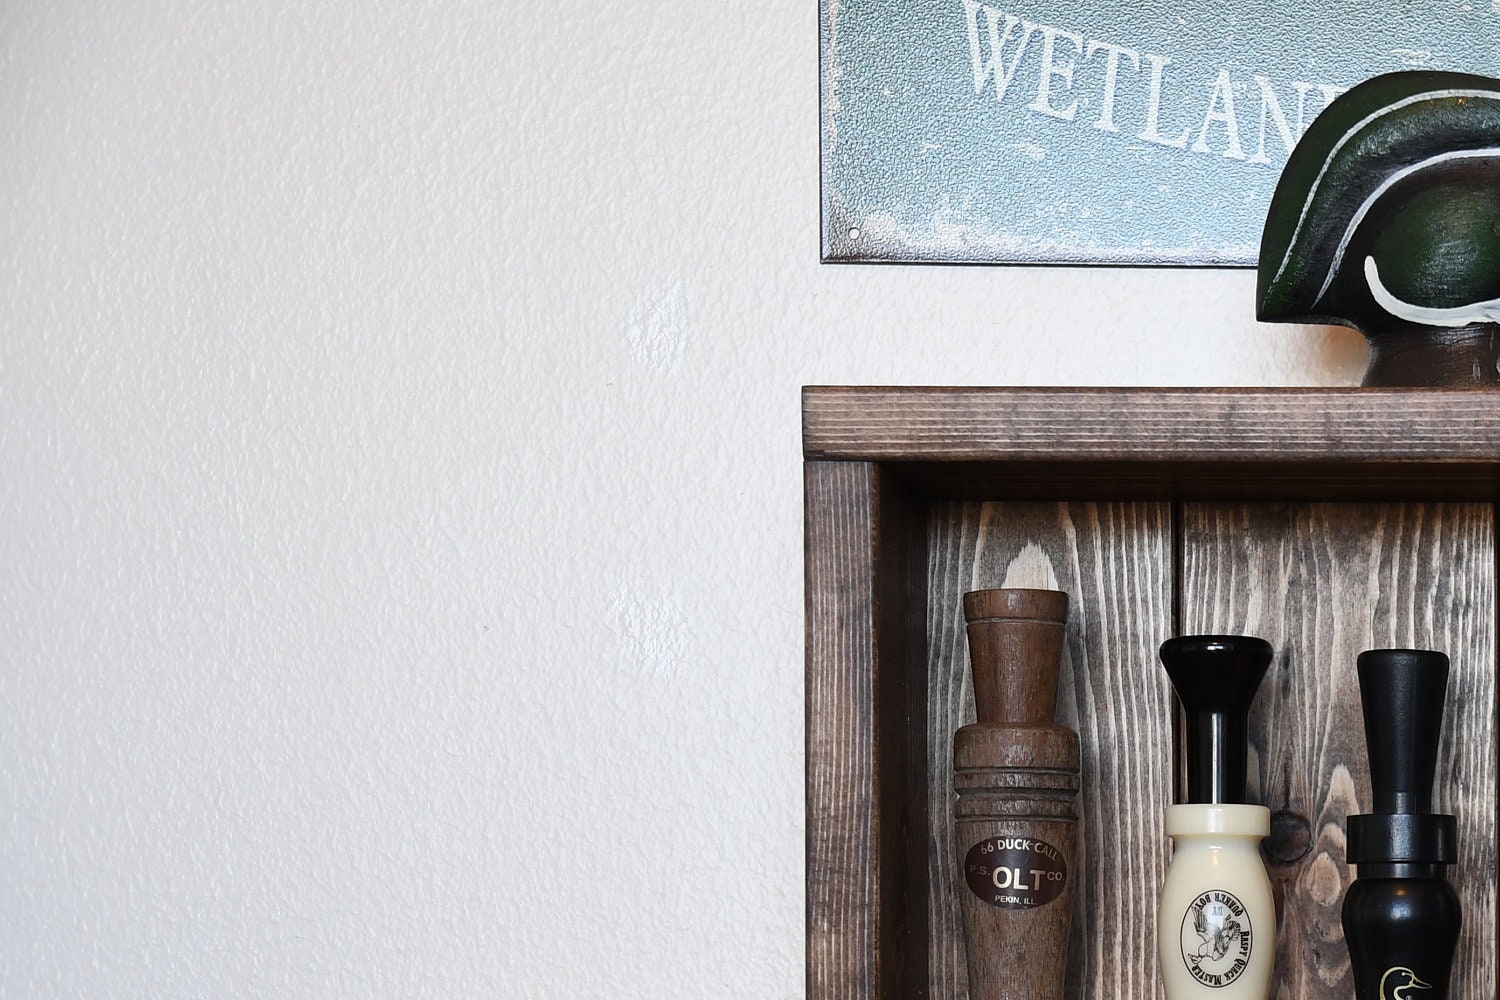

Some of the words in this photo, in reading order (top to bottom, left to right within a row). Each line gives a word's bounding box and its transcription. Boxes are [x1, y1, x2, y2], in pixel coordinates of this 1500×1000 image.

[962, 0, 1350, 165] WETLAN
[992, 866, 1046, 891] OLT
[995, 895, 1021, 905] PEKIN,
[1195, 894, 1211, 910] BOY
[1214, 893, 1244, 917] QUAKER
[1191, 963, 1222, 985] MASTER
[1224, 958, 1247, 981] QUACK
